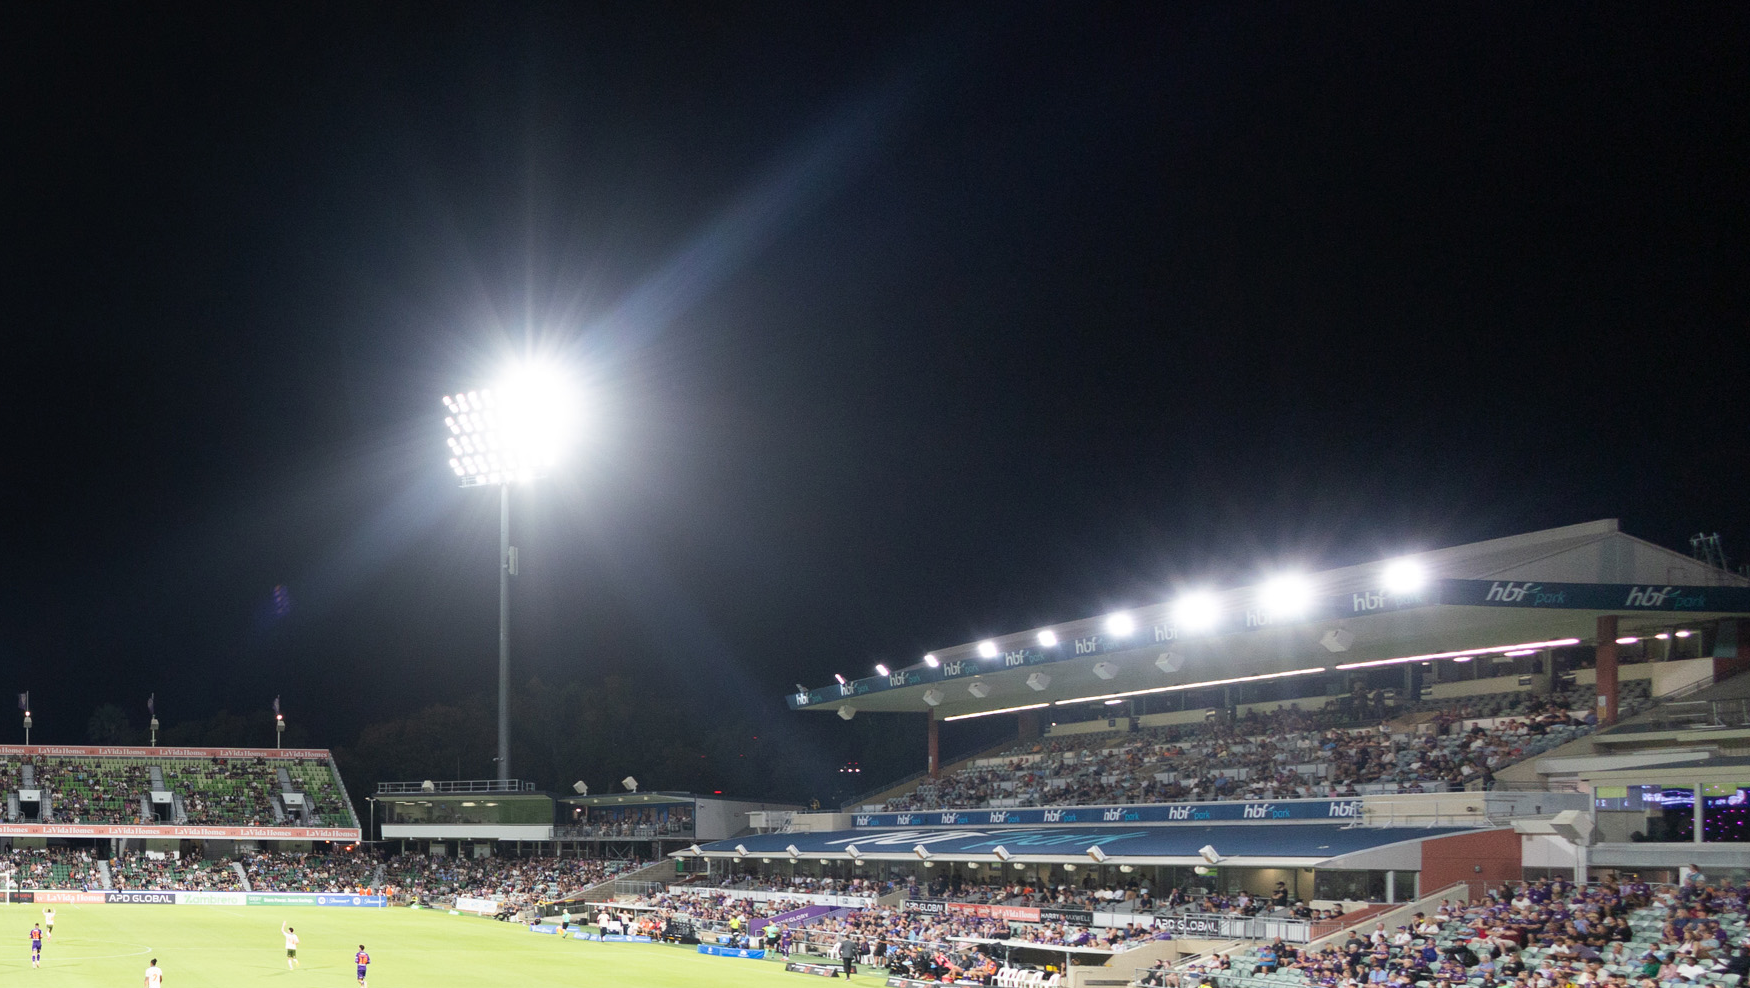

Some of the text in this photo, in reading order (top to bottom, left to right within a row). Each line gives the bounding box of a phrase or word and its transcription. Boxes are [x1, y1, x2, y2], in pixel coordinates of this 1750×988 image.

[1486, 582, 1566, 606] hbf park
[1625, 586, 1670, 607] hbf
[1353, 589, 1386, 612] hbf
[1075, 637, 1097, 655] hbf
[1005, 651, 1025, 666] hbf
[944, 661, 961, 676] hbf
[889, 674, 905, 686] hbf
[840, 684, 854, 696] hbf
[796, 694, 809, 705] hbf
[280, 750, 305, 758] LaVida
[1103, 808, 1139, 822] hbf park
[1169, 806, 1210, 820] hbf park
[1244, 804, 1290, 819] hbf park
[1329, 802, 1355, 816] hbf
[856, 815, 870, 826] hbf
[897, 814, 910, 825] hbf
[941, 813, 968, 825] hbf park
[990, 811, 1020, 824] hbf park
[1044, 810, 1077, 823] hbf park
[5, 826, 28, 834] Homes
[109, 827, 135, 835] LaVida
[268, 829, 291, 837] Homes
[306, 829, 357, 838] LaVida Homes
[47, 894, 105, 902] LaVida Homes
[132, 895, 172, 903] GLOBAL
[184, 894, 238, 905] Zambrero
[920, 903, 946, 912] GLOBAL
[1019, 910, 1038, 920] Homes
[1155, 918, 1218, 932] APD GLOBAL
